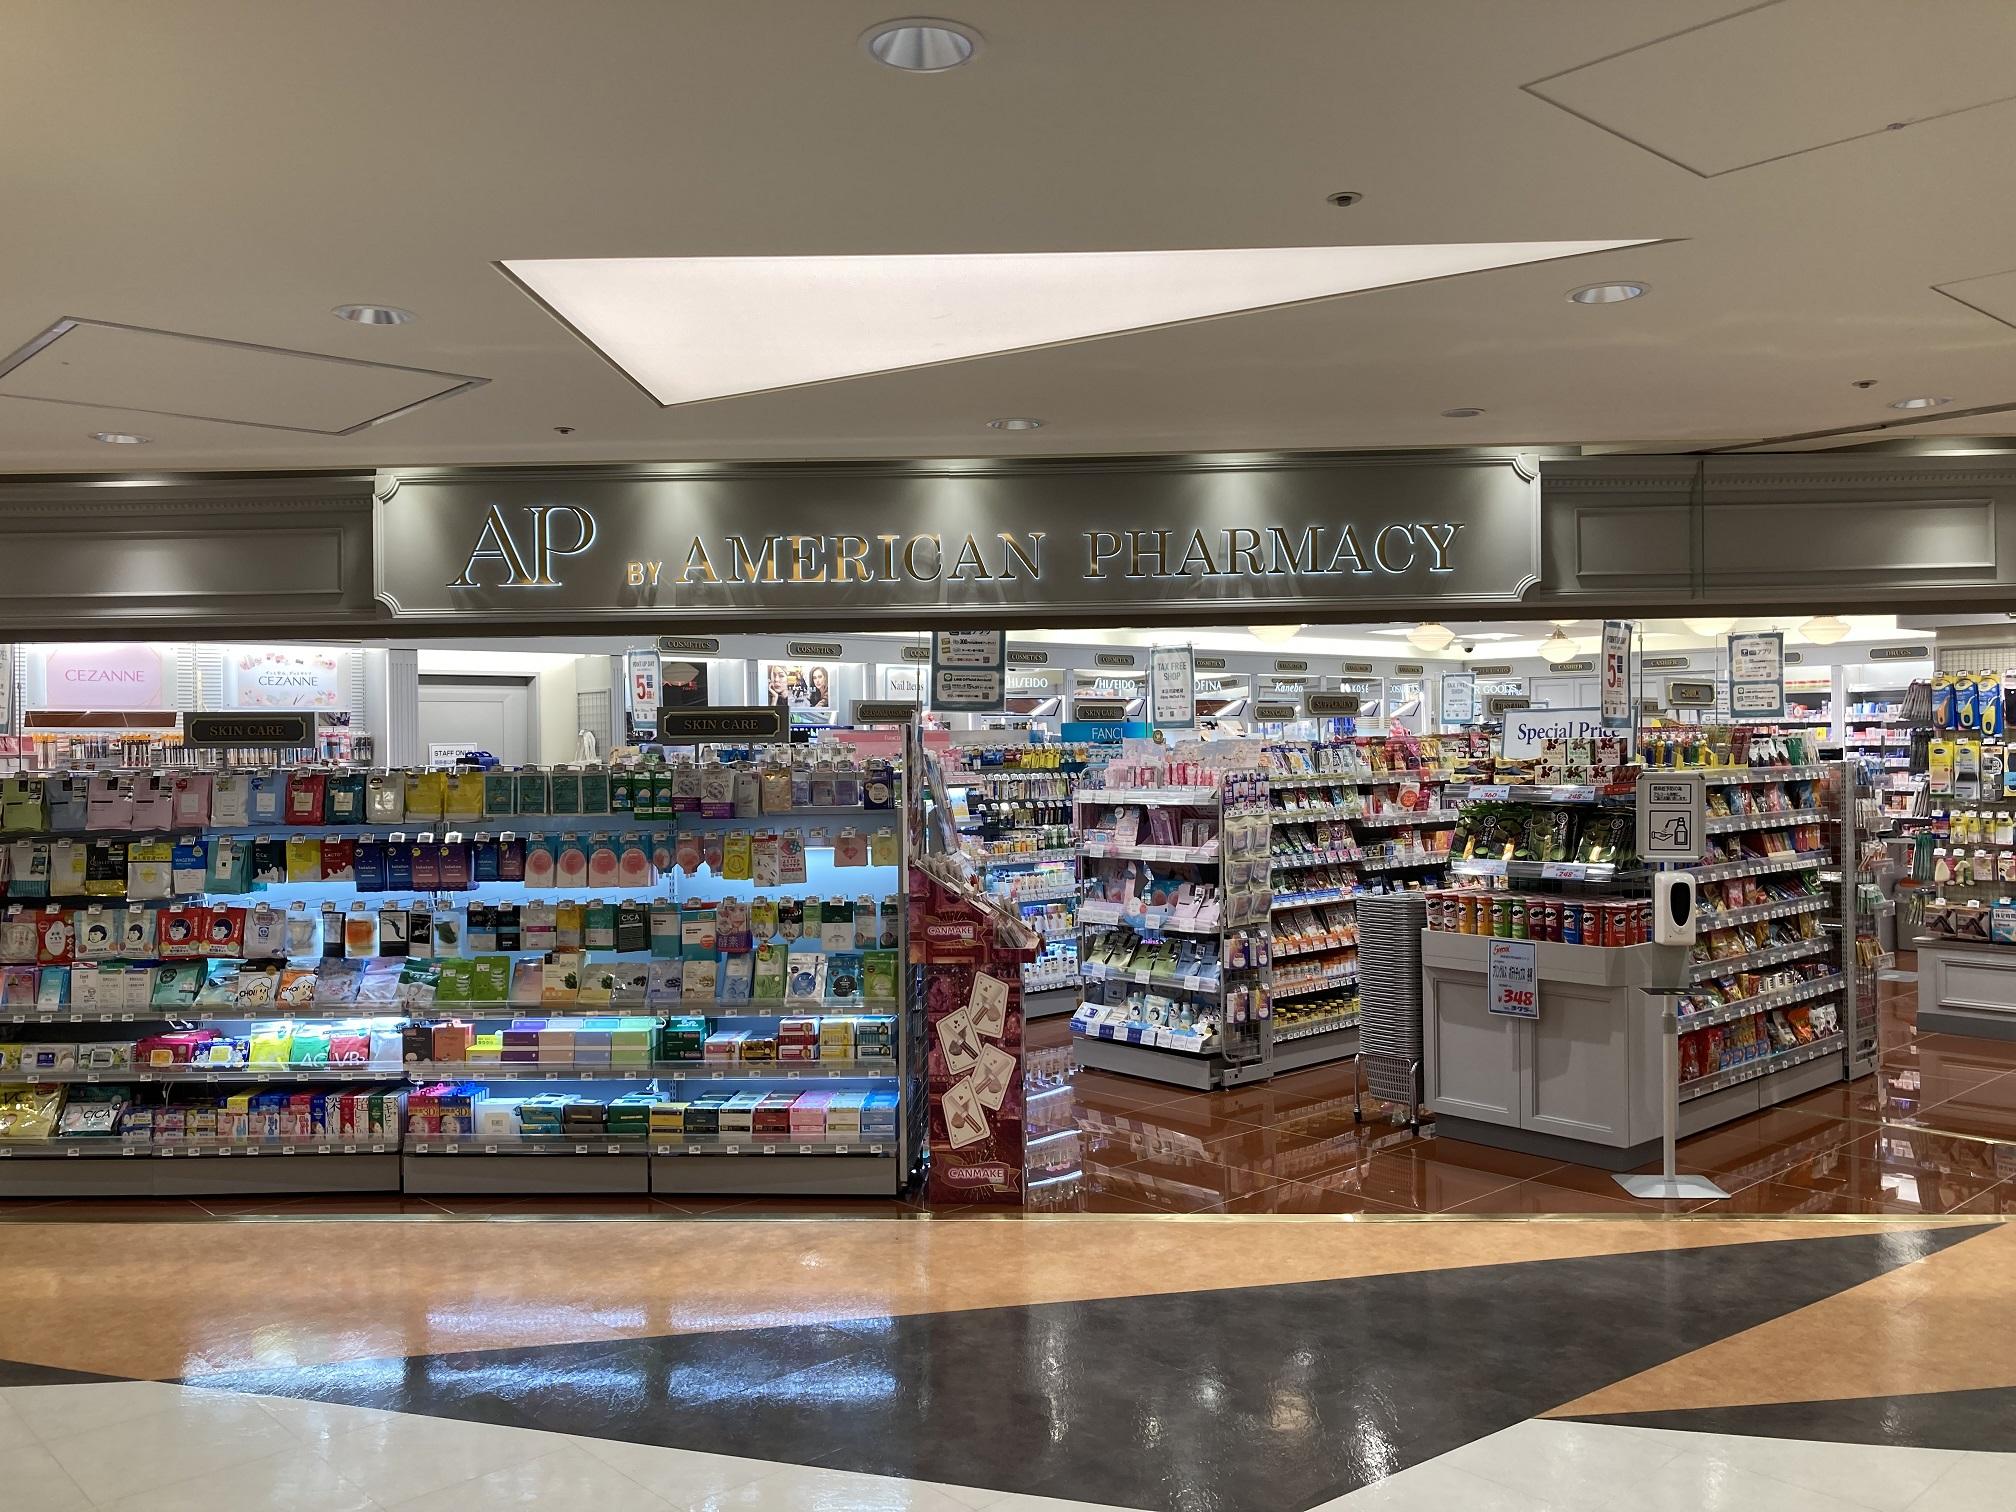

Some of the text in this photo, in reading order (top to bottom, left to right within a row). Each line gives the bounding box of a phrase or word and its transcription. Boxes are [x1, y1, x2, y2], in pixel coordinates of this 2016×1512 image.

[446, 504, 1464, 587] AP BY AMERICAN PHARMACY
[667, 640, 712, 649] COSMETICS
[797, 645, 835, 654] COSMETICS
[1011, 652, 1043, 661] COSMETICS
[1886, 649, 1912, 657] DRUGS
[1158, 662, 1187, 671] TAX FREE
[1607, 653, 1617, 688] 5
[65, 669, 145, 683] CEZANNE
[258, 676, 319, 687] CEZANNE
[1163, 672, 1181, 681] SHOP
[890, 679, 906, 692] Nail
[1091, 678, 1136, 689] SHISEIDO
[1274, 682, 1304, 693] Kanebo
[1483, 684, 1517, 694] GOODS
[209, 724, 285, 736] SKIN CARE
[683, 719, 760, 731] SKIN CARE
[1517, 721, 1574, 745] Special
[621, 913, 640, 922] CICA
[928, 926, 973, 935] CANMAKE
[83, 1109, 111, 1119] CICA
[948, 1168, 1005, 1179] CANMAKE
